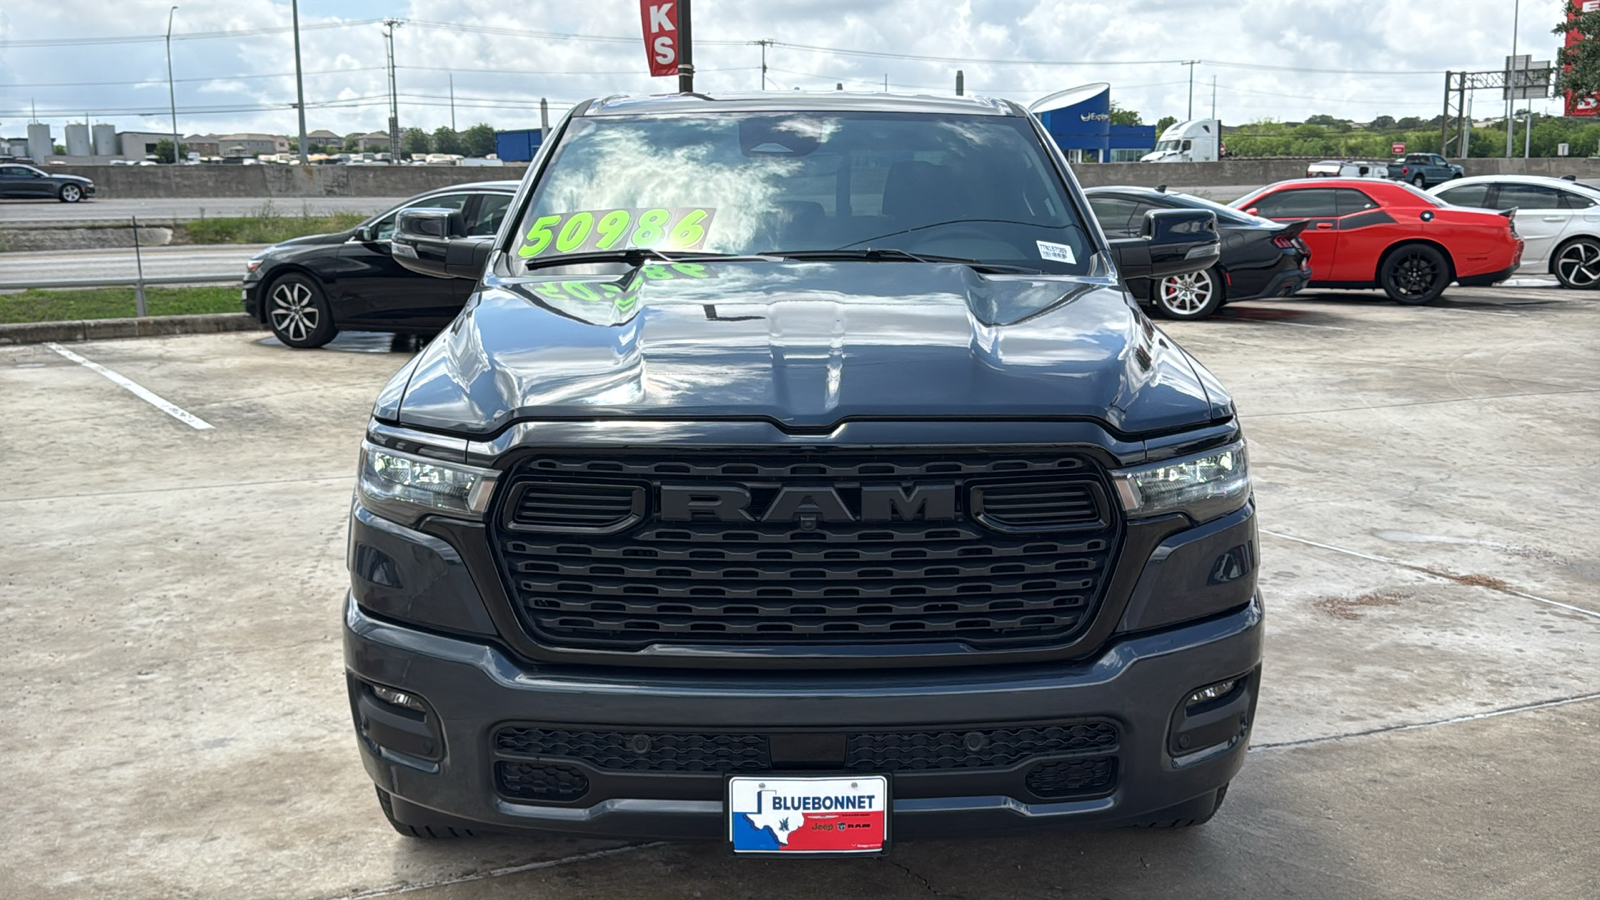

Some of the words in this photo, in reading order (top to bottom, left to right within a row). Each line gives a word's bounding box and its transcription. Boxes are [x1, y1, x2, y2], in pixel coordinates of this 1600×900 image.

[518, 209, 708, 258] 50986
[661, 483, 956, 522] RAM
[772, 795, 875, 811] BLUEBONNET
[812, 822, 834, 831] Jeep
